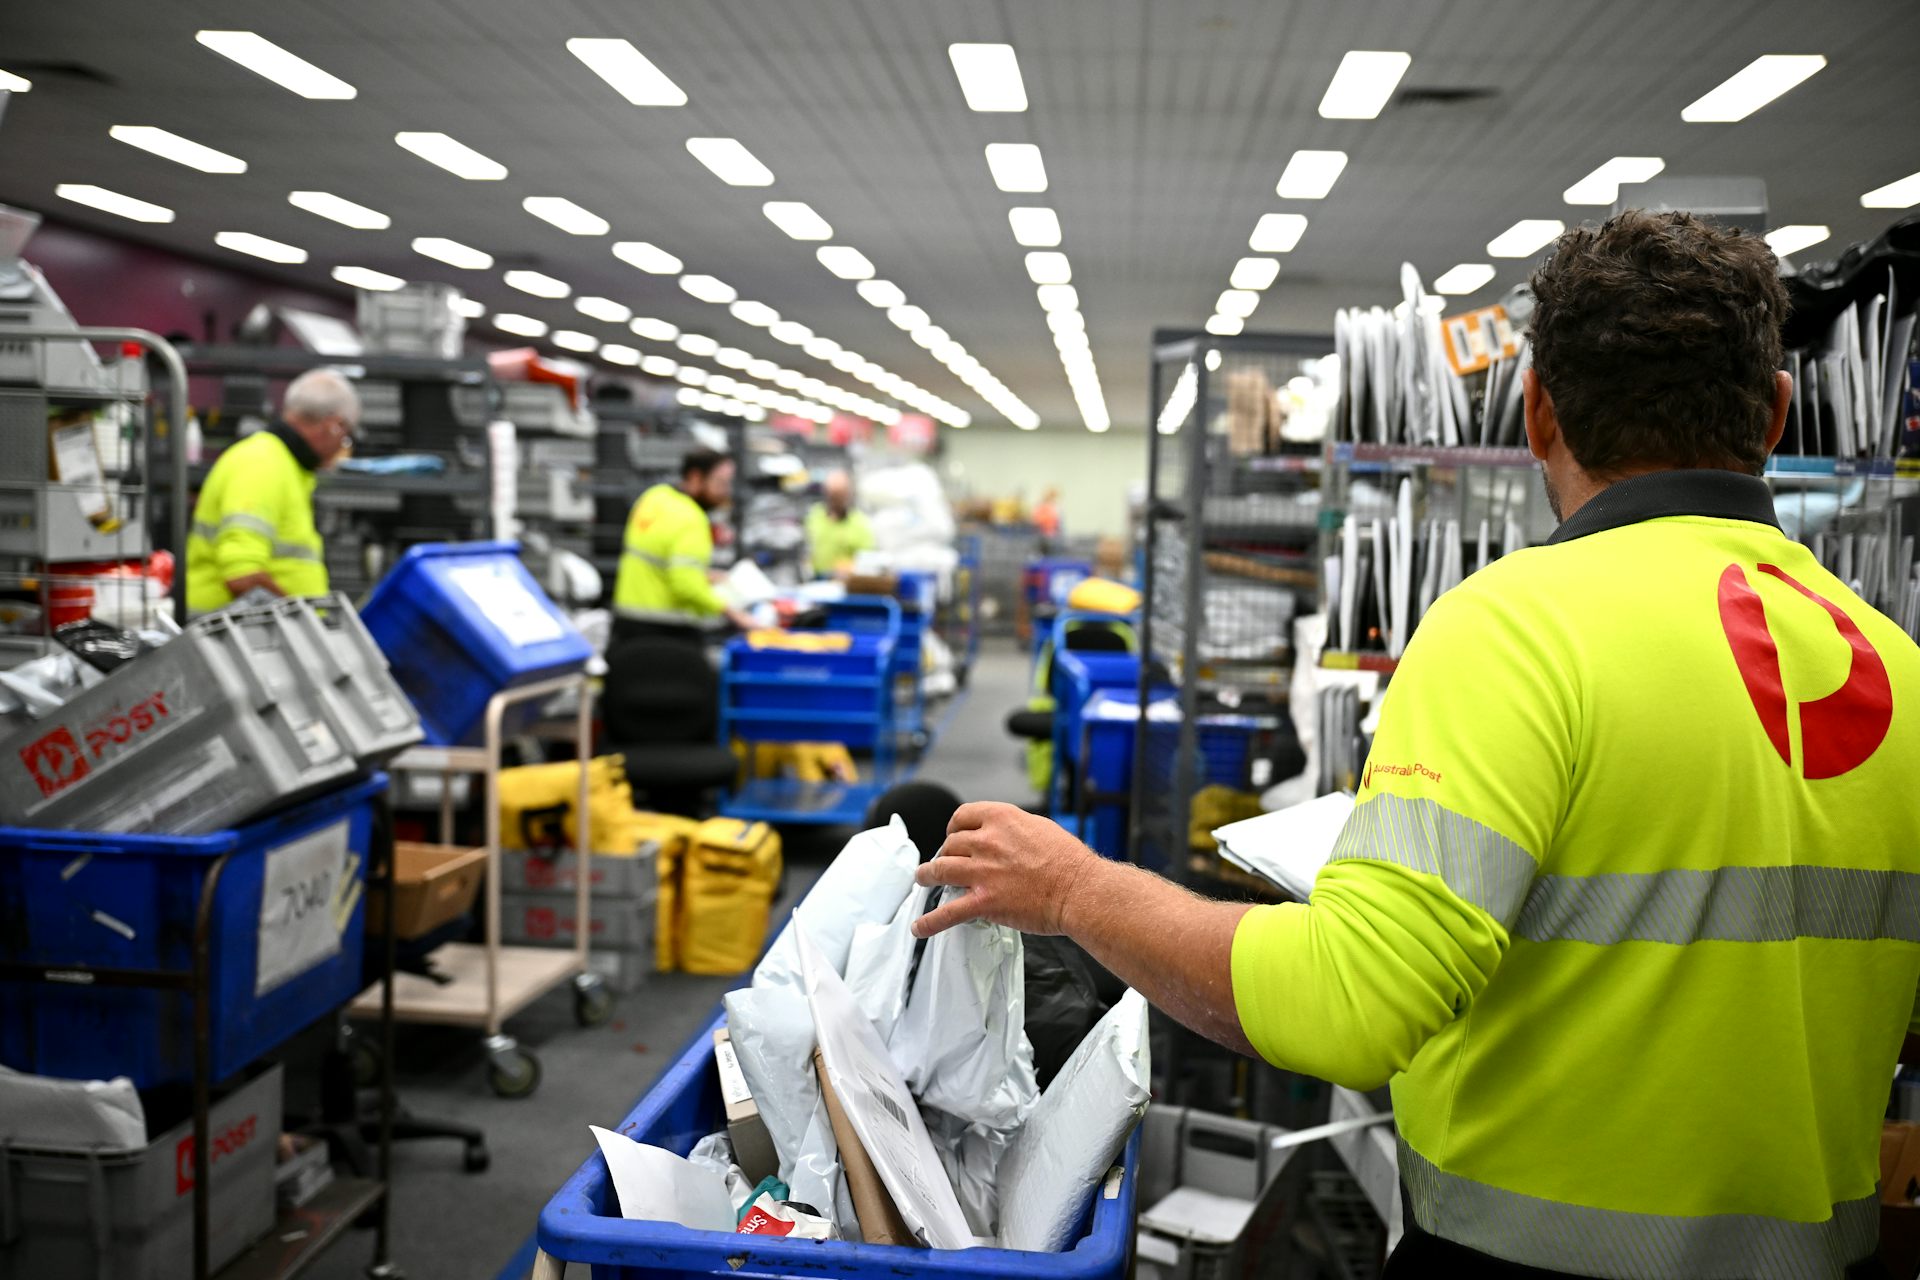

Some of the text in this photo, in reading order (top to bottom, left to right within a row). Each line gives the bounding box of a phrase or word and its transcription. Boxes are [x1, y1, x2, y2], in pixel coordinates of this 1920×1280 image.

[85, 690, 169, 758] POST
[1372, 763, 1442, 783] Australi Post
